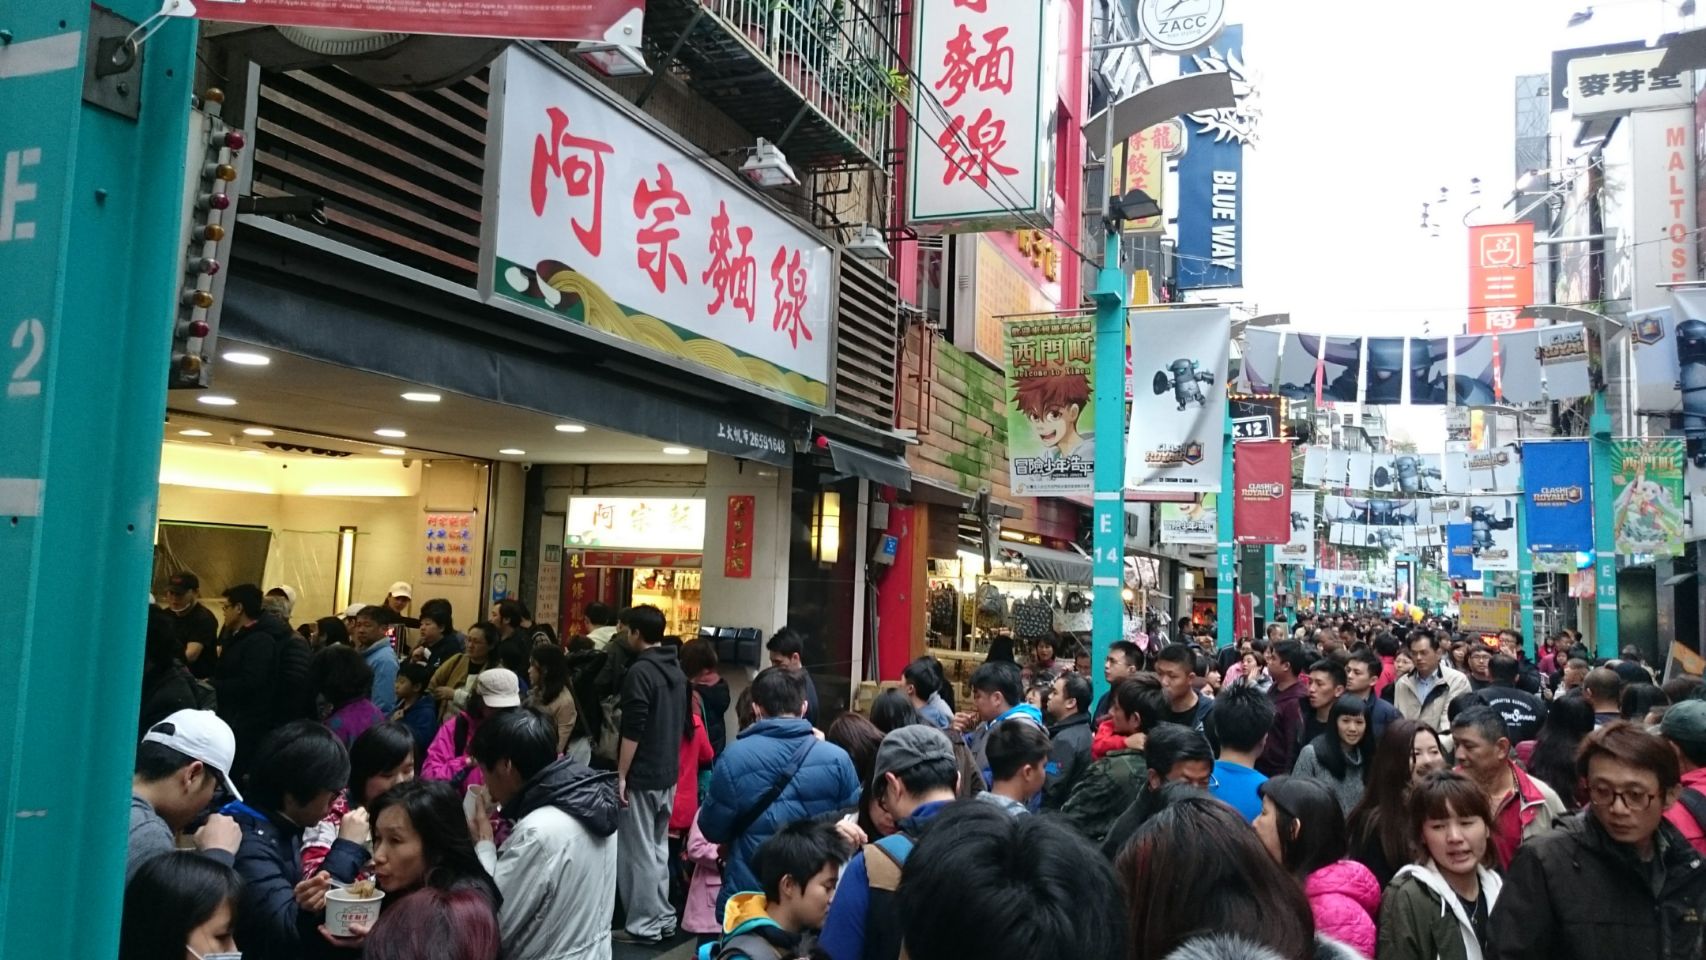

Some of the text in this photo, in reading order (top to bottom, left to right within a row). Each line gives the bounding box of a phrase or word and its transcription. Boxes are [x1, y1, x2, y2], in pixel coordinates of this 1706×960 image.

[1159, 16, 1207, 34] ZACC
[1579, 69, 1682, 98] 麥芽堂
[935, 0, 1019, 189] 麵線
[0, 148, 41, 241] E
[531, 107, 813, 350] 阿宗麵線
[1211, 171, 1236, 270] BLUE WAY
[8, 318, 45, 396] 2
[1011, 337, 1094, 367] 西門町
[1014, 369, 1048, 377] Welcome
[1065, 367, 1091, 375] Ximen
[1241, 489, 1271, 497] ROYALE
[1533, 493, 1568, 502] ROYALE
[592, 503, 692, 532] 阿宗
[1100, 514, 1111, 533] E
[1094, 547, 1119, 564] 14
[1221, 554, 1229, 566] E
[1218, 572, 1232, 583] 16
[1602, 565, 1611, 577] E
[1600, 584, 1615, 596] 15
